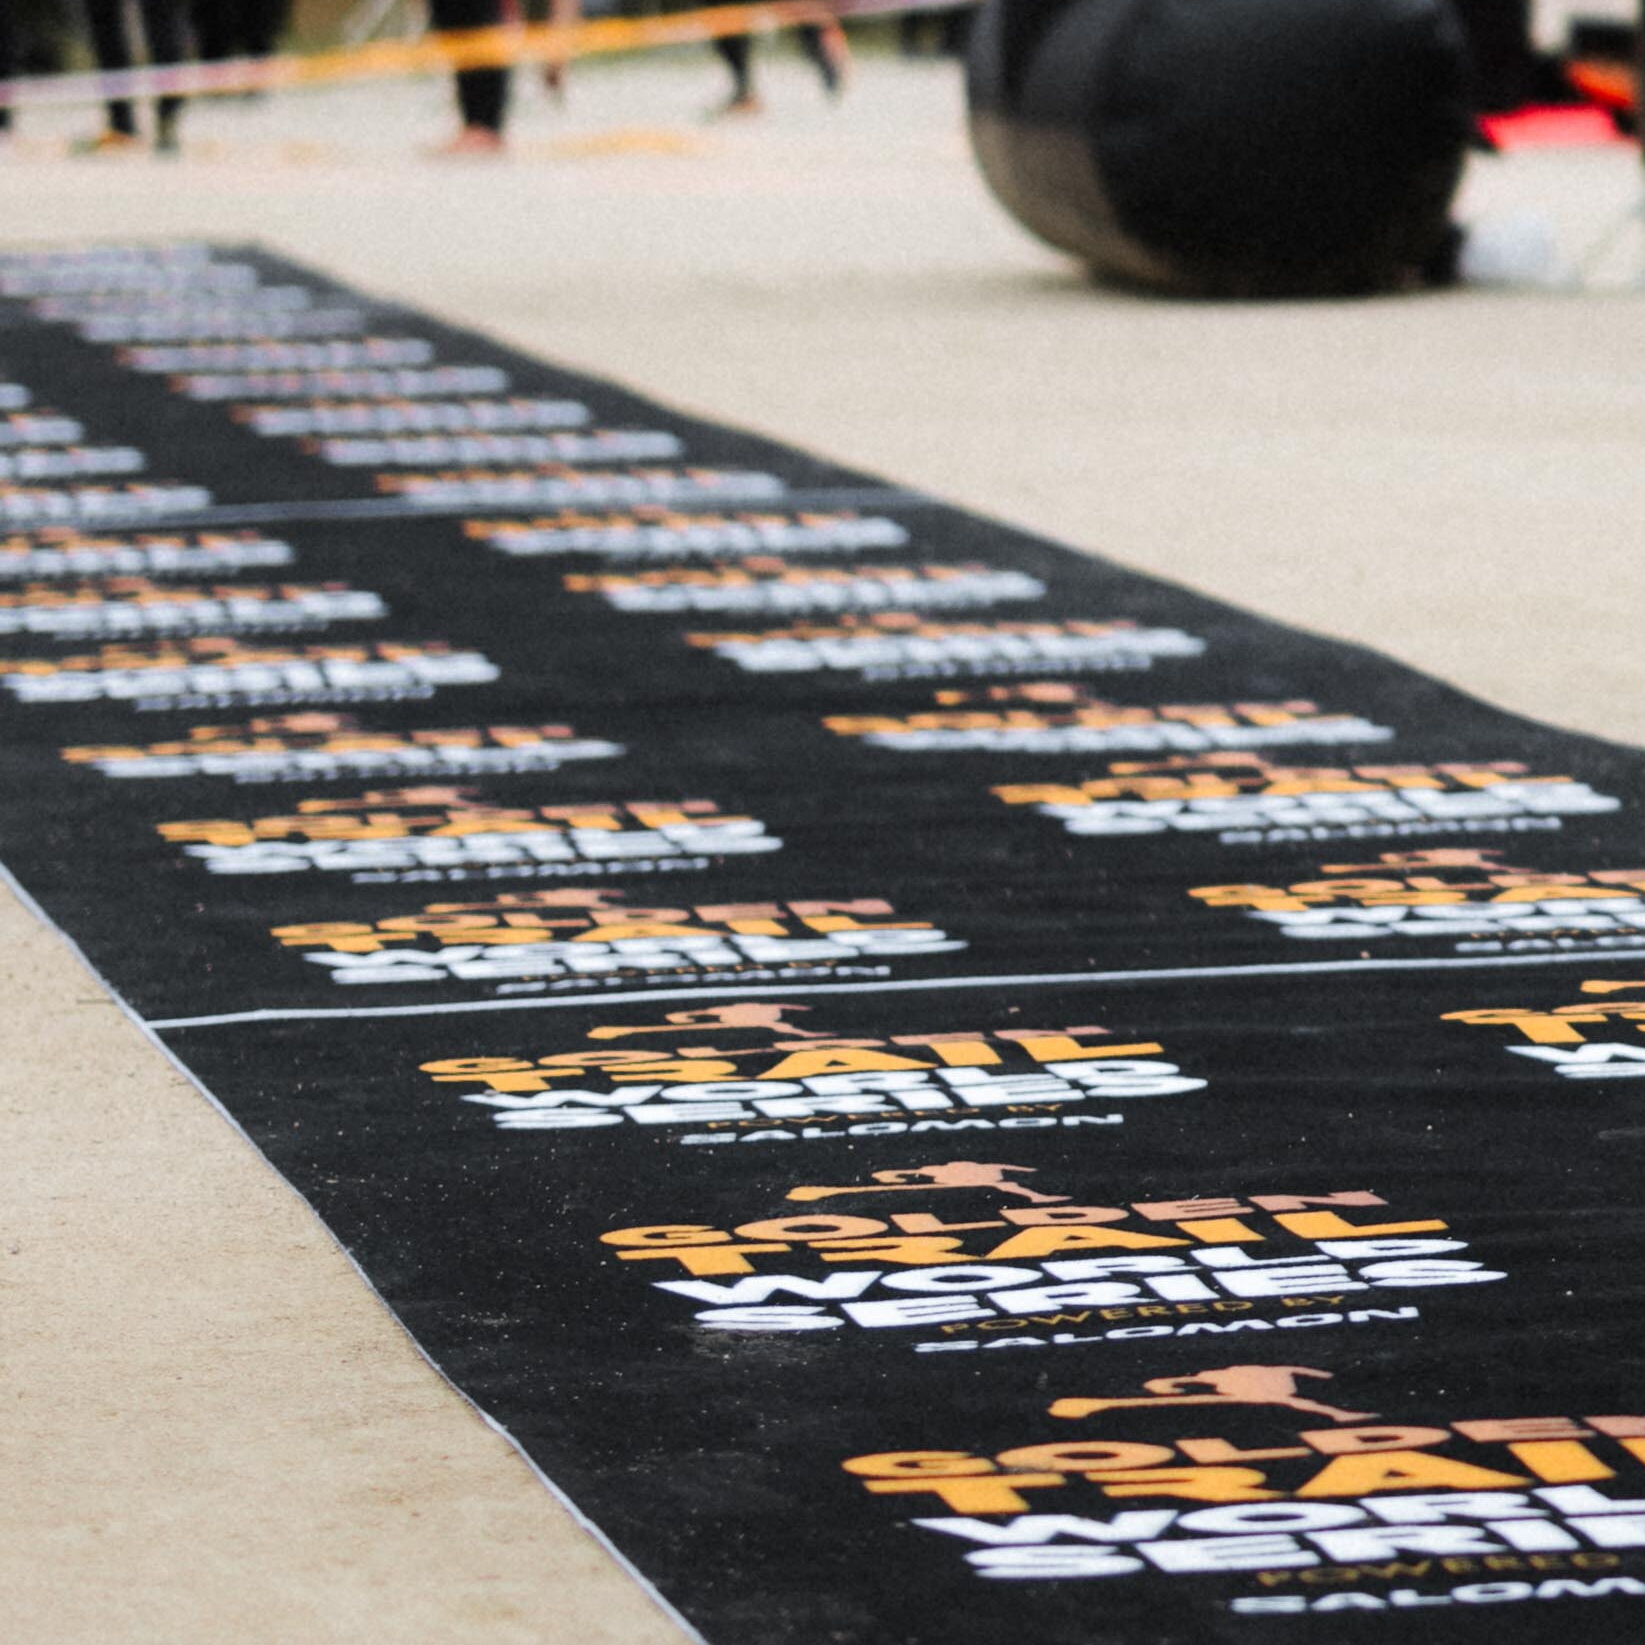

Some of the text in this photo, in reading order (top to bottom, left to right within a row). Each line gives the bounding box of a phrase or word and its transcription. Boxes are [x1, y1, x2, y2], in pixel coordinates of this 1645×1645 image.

[432, 1035, 1164, 1092] TRAIL
[680, 1113, 1125, 1144] SALOMON
[600, 1191, 1390, 1246] GOLDEN
[616, 1210, 1449, 1276] TRAIL
[652, 1239, 1469, 1305] WORLD
[693, 1259, 1508, 1330] SERIES
[914, 1306, 1420, 1352] SALOMON
[941, 1295, 1348, 1334] POWERED BY
